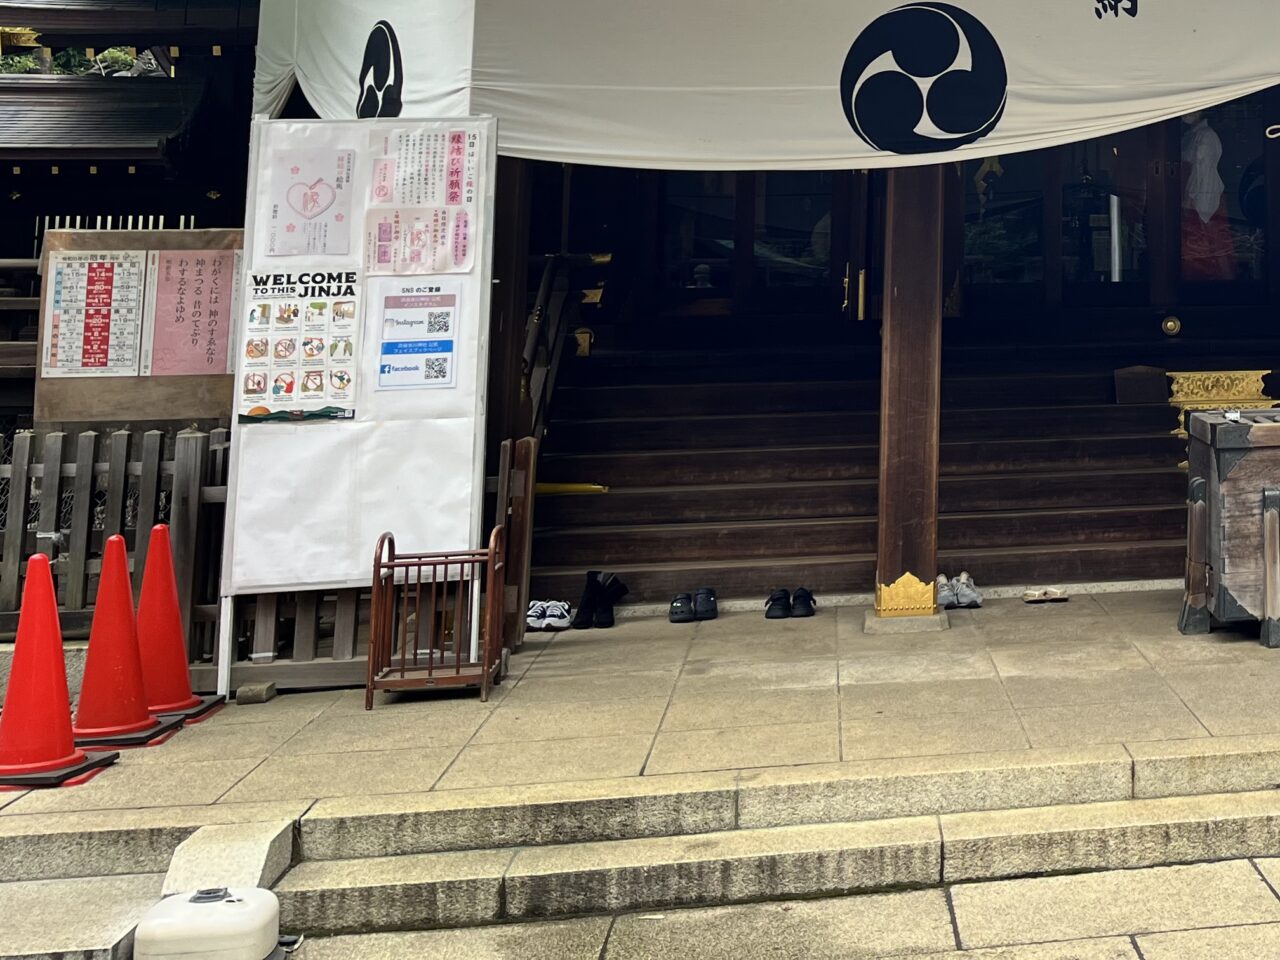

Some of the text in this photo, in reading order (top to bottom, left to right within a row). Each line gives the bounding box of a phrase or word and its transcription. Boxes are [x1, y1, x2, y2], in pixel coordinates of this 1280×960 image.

[448, 134, 461, 203] 縁結び祈願祭
[174, 258, 188, 324] わするなよゆめ
[190, 258, 206, 347] 神まつる 昔のてぶり
[209, 258, 223, 305] わがくには
[252, 272, 357, 286] WELCOME
[271, 286, 297, 294] THIS
[298, 284, 356, 298] JINJA
[395, 319, 424, 327] Instagram
